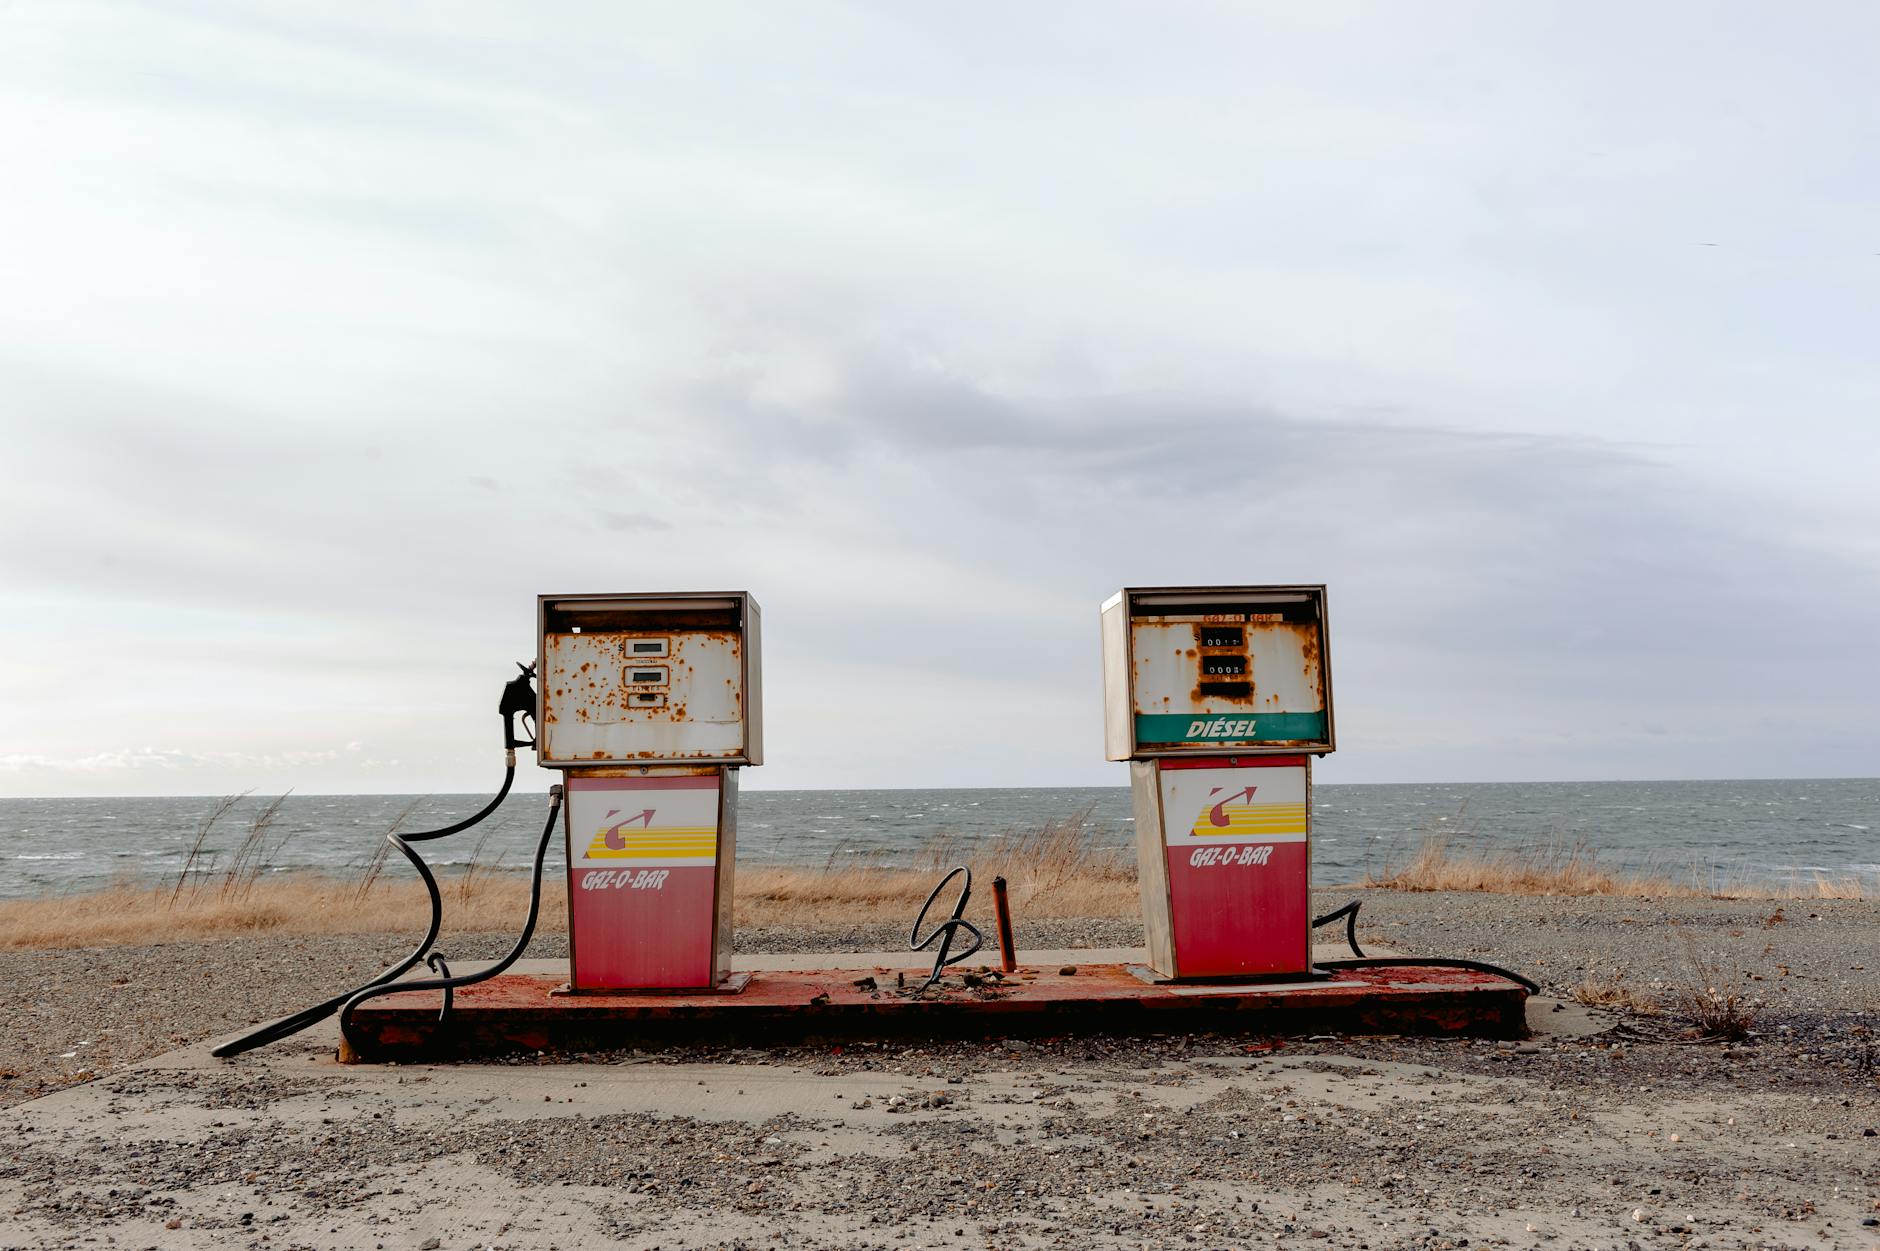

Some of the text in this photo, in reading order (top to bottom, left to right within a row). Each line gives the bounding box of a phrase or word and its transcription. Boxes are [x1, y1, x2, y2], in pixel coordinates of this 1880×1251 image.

[1185, 717, 1257, 738] DIÉSEL
[1189, 845, 1274, 868] GAZ-O-BAR
[581, 870, 670, 891] GAZ-O-BAR
